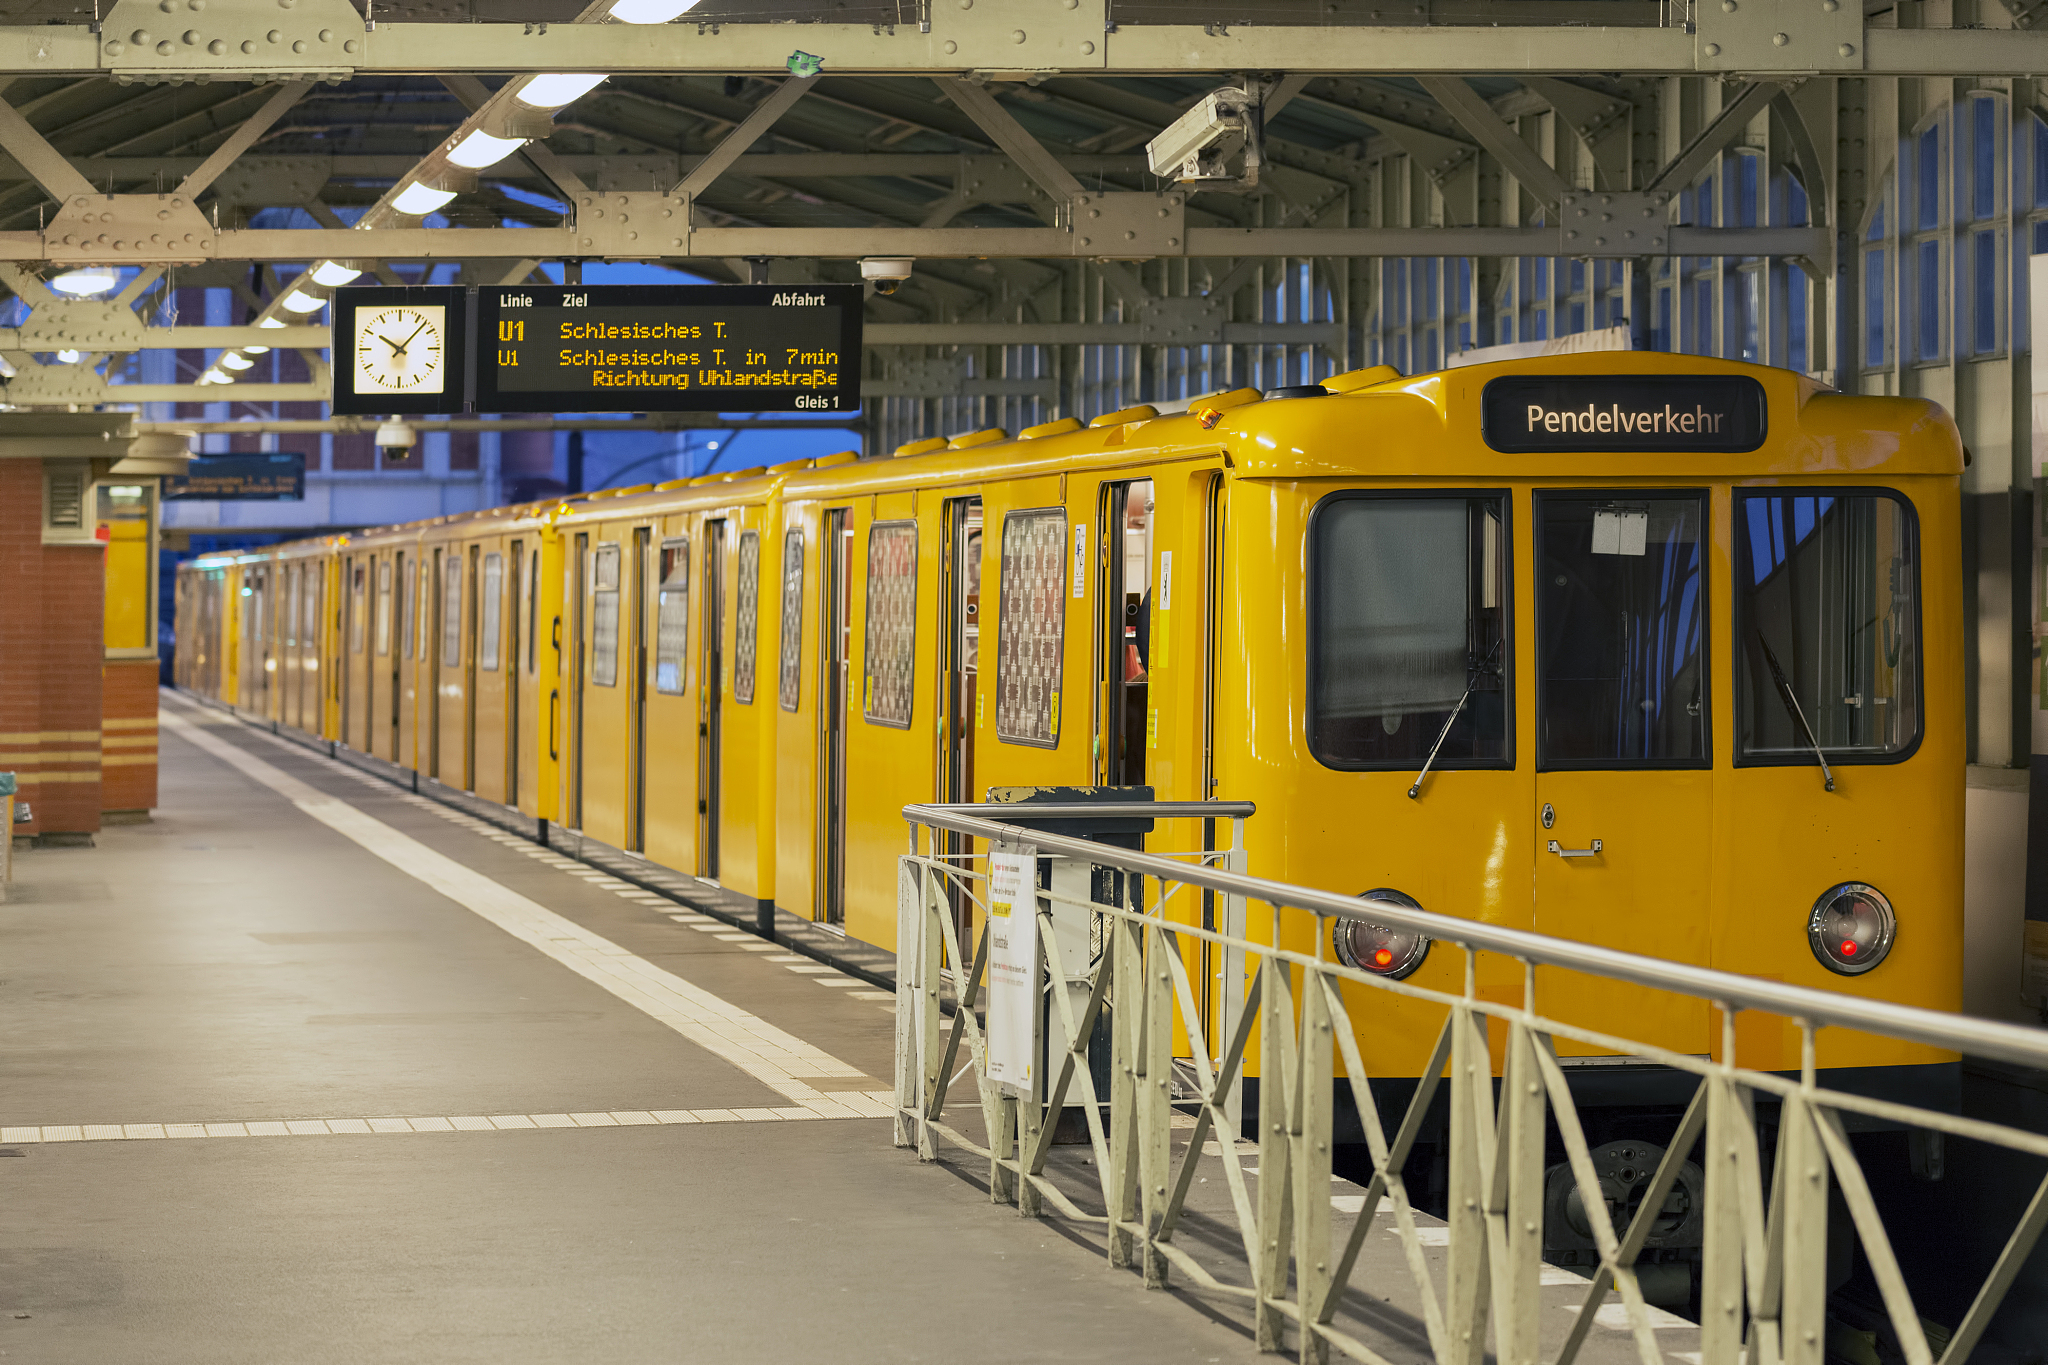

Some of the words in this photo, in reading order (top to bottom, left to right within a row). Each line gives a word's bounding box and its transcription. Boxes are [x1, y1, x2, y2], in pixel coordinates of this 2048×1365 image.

[500, 293, 533, 308] Linie
[562, 293, 588, 307] Ziel
[771, 292, 826, 307] Abfahrt
[498, 320, 525, 342] U1
[560, 322, 702, 339] Schlesisches
[713, 321, 728, 339] T.
[497, 349, 519, 367] U1
[559, 349, 701, 366] Schlesisches
[712, 348, 727, 366] T.
[745, 348, 767, 366] in
[592, 369, 690, 390] Richtung
[698, 369, 838, 390] Uhlandstraße
[794, 395, 829, 409] Gleis
[832, 395, 840, 409] 1
[1526, 403, 1725, 434] Pendelverkehr
